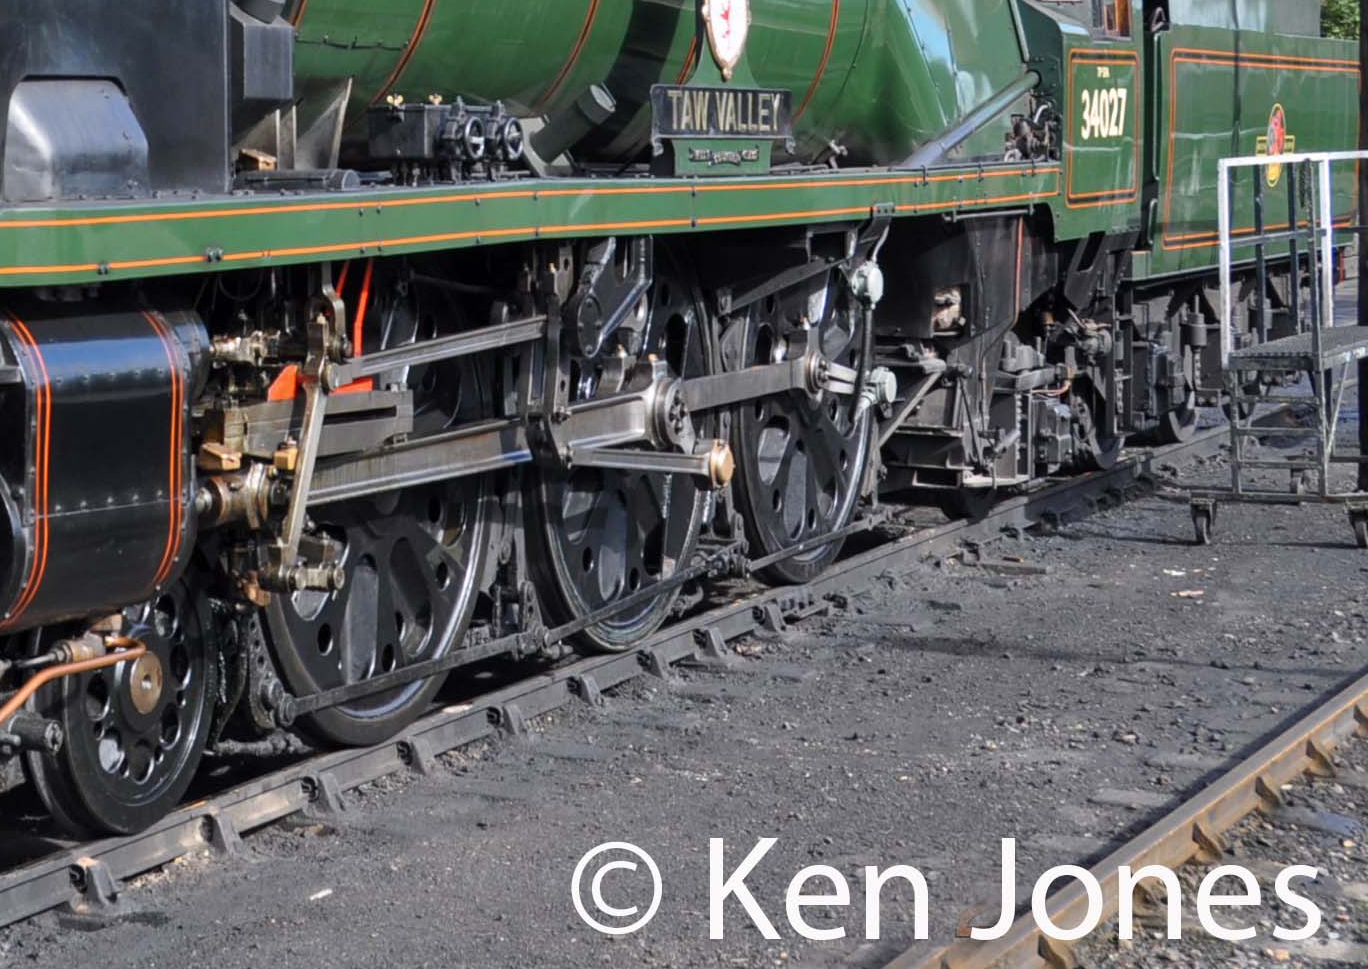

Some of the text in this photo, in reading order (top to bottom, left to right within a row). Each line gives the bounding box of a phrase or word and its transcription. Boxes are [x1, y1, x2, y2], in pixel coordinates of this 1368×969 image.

[668, 90, 780, 131] TAW VALLEY
[1081, 87, 1128, 140] 34027
